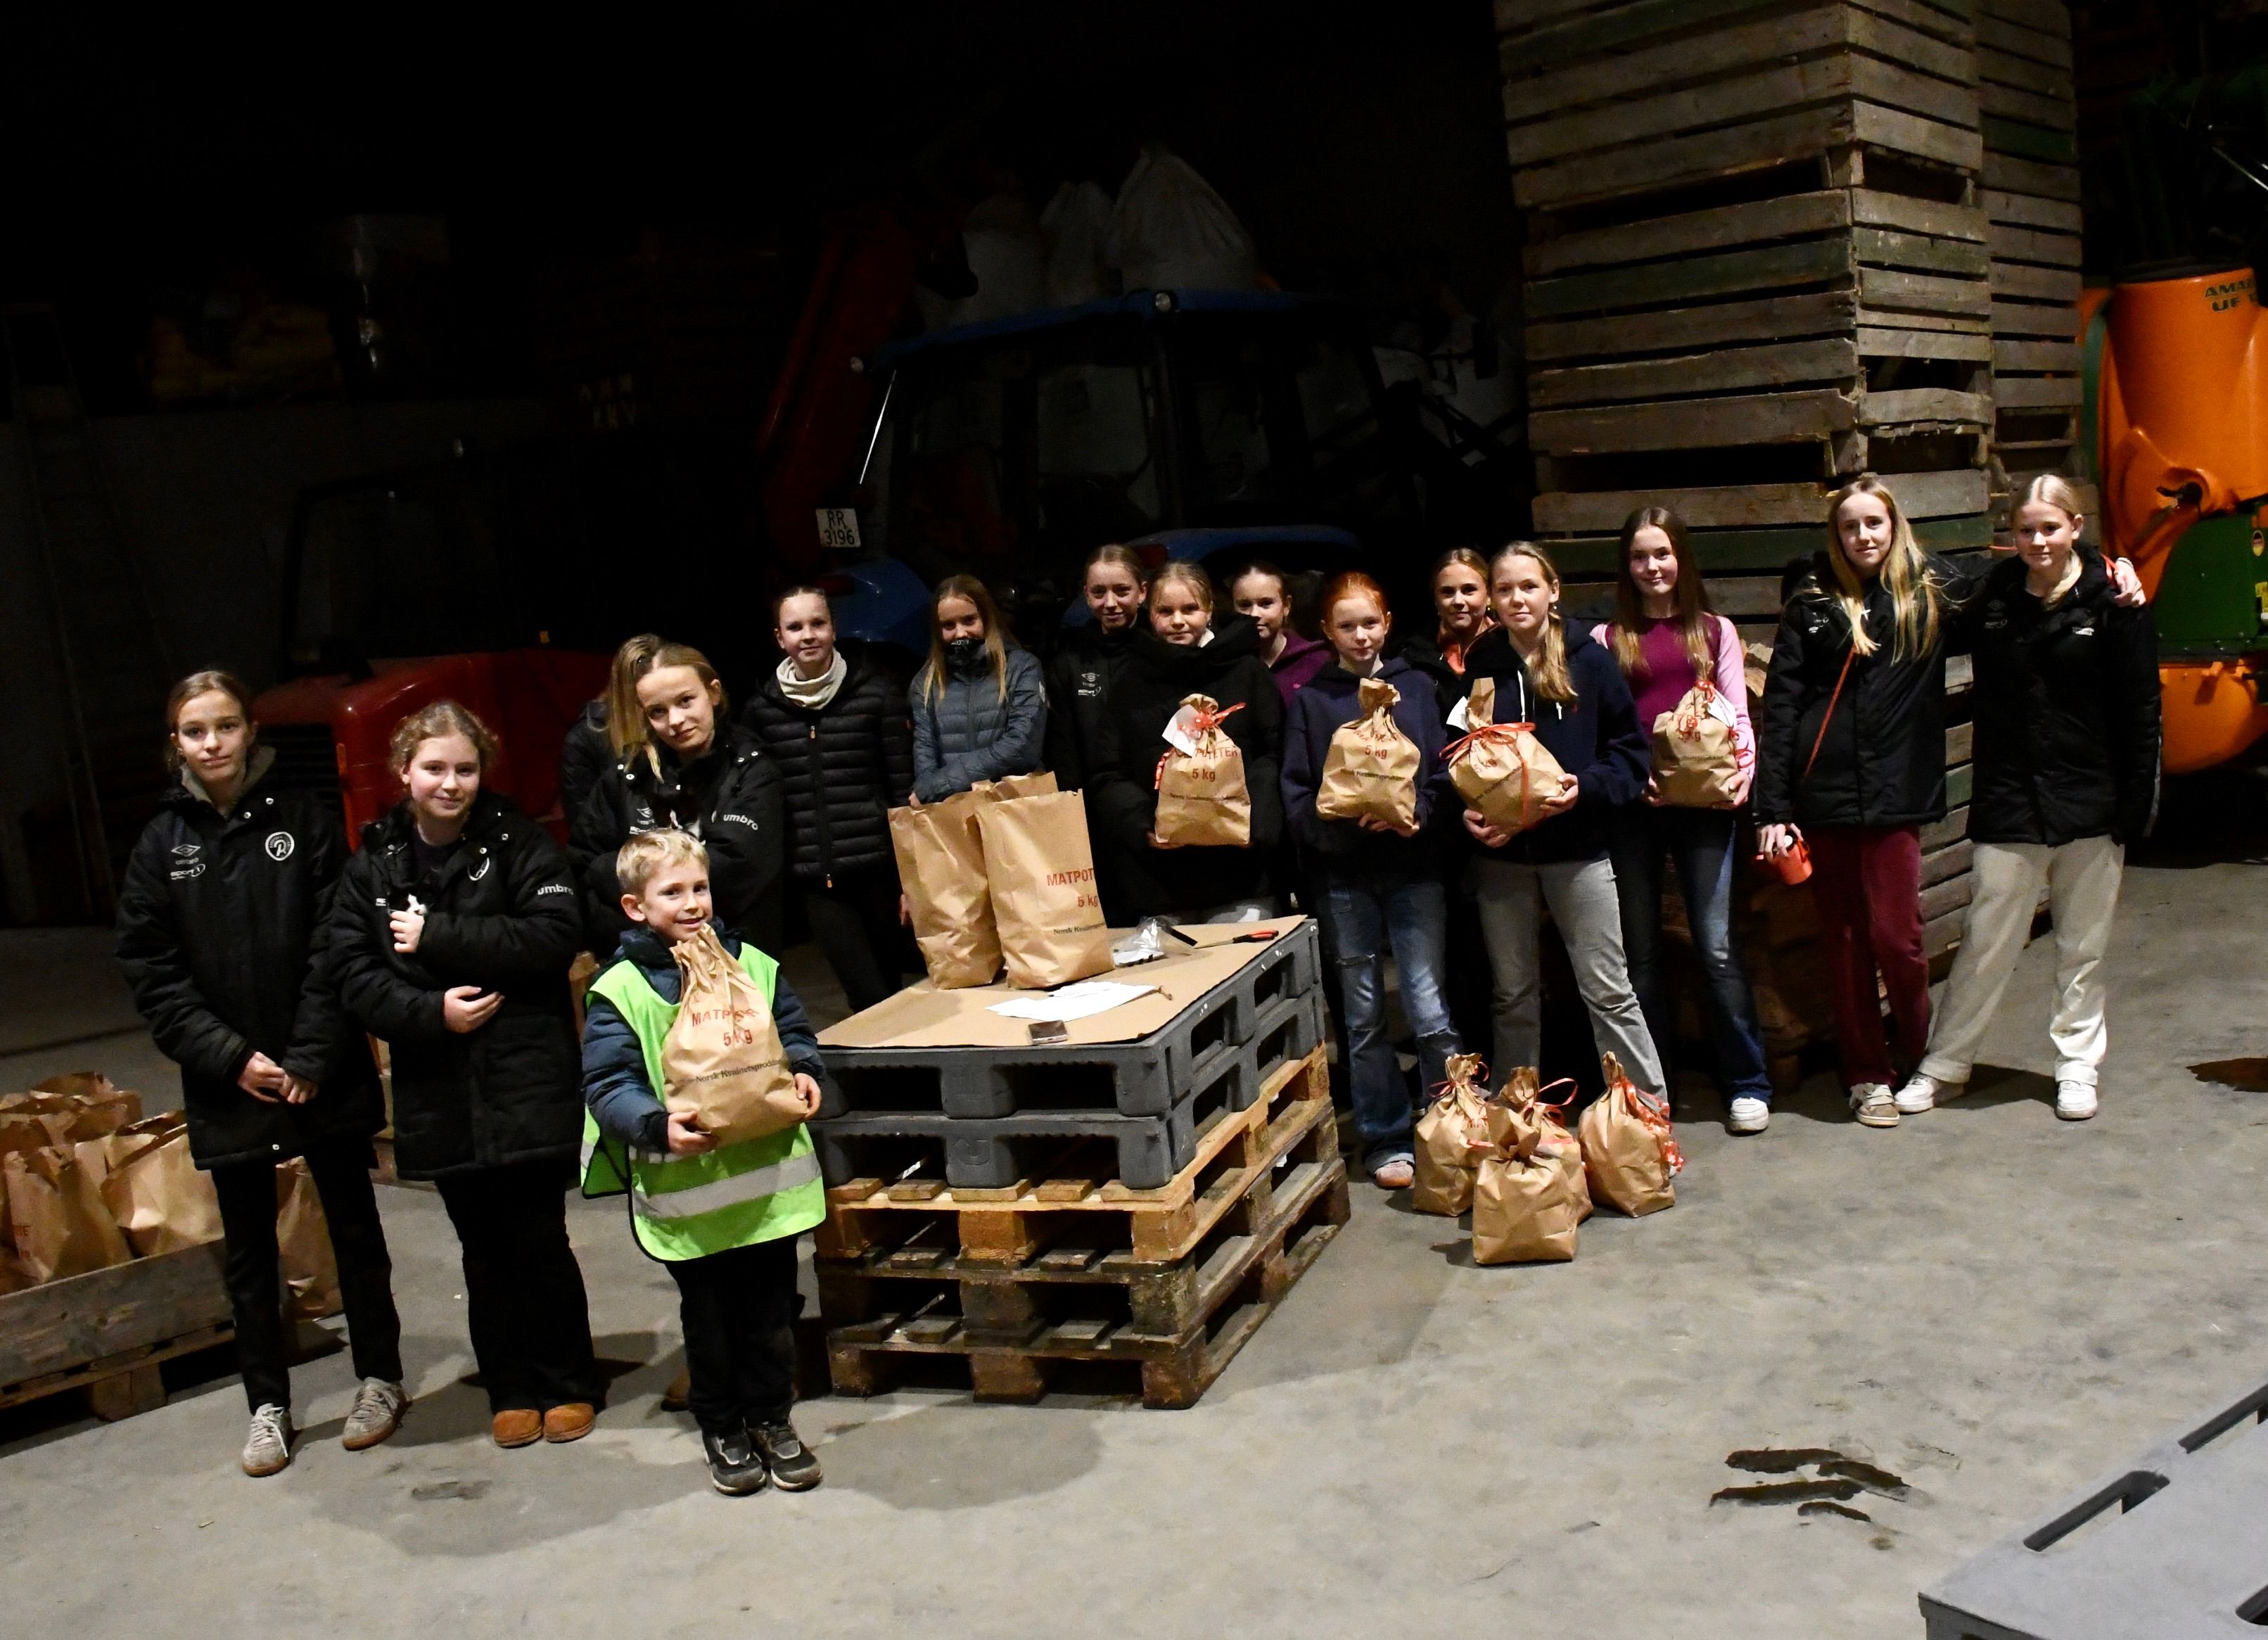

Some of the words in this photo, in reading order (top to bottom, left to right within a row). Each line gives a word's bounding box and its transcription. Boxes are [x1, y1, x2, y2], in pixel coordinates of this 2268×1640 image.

[827, 511, 846, 529] RR
[824, 529, 855, 545] 3196
[1192, 768, 1199, 780] 5
[1202, 768, 1216, 782] kg
[723, 814, 759, 831] umbro
[723, 1031, 731, 1046] 5
[695, 1072, 719, 1083] Norsk
